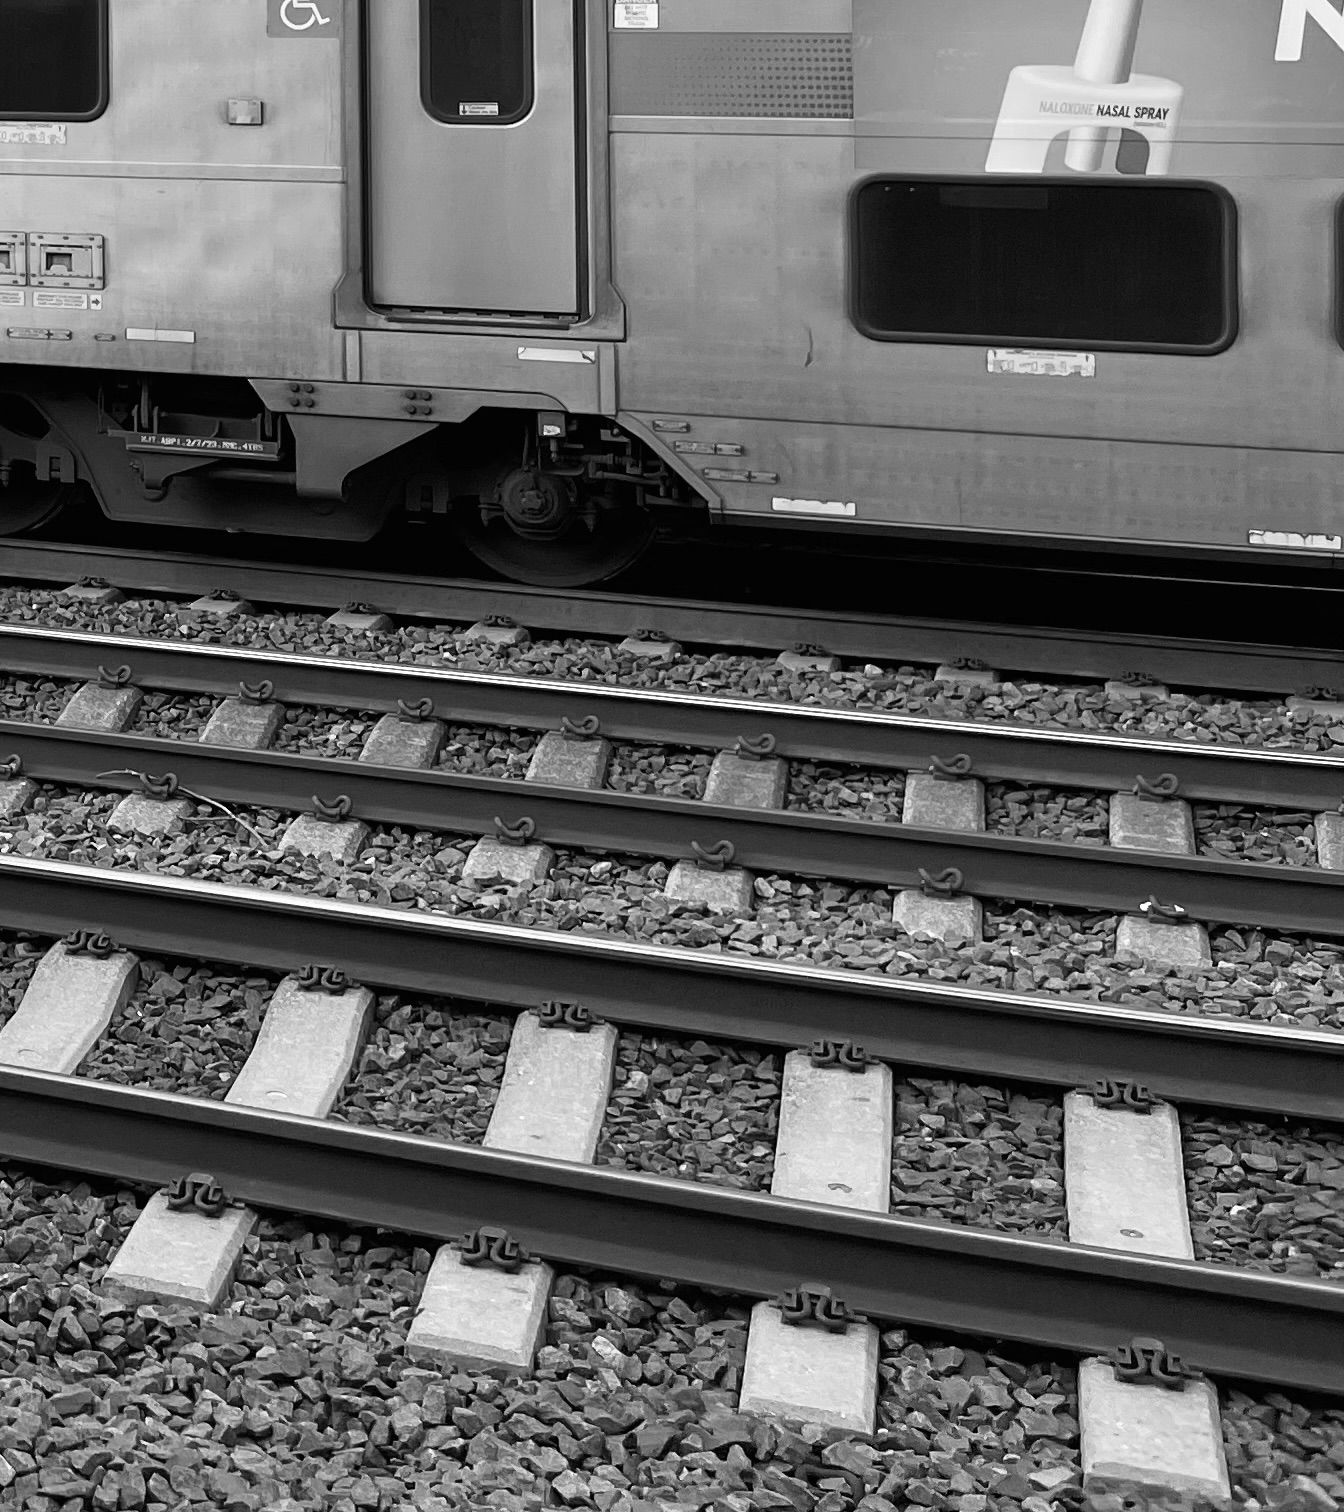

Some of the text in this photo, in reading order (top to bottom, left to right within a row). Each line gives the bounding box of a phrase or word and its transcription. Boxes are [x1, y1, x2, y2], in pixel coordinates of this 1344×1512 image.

[1039, 101, 1170, 121] NALOXONE NASAL SPRAY
